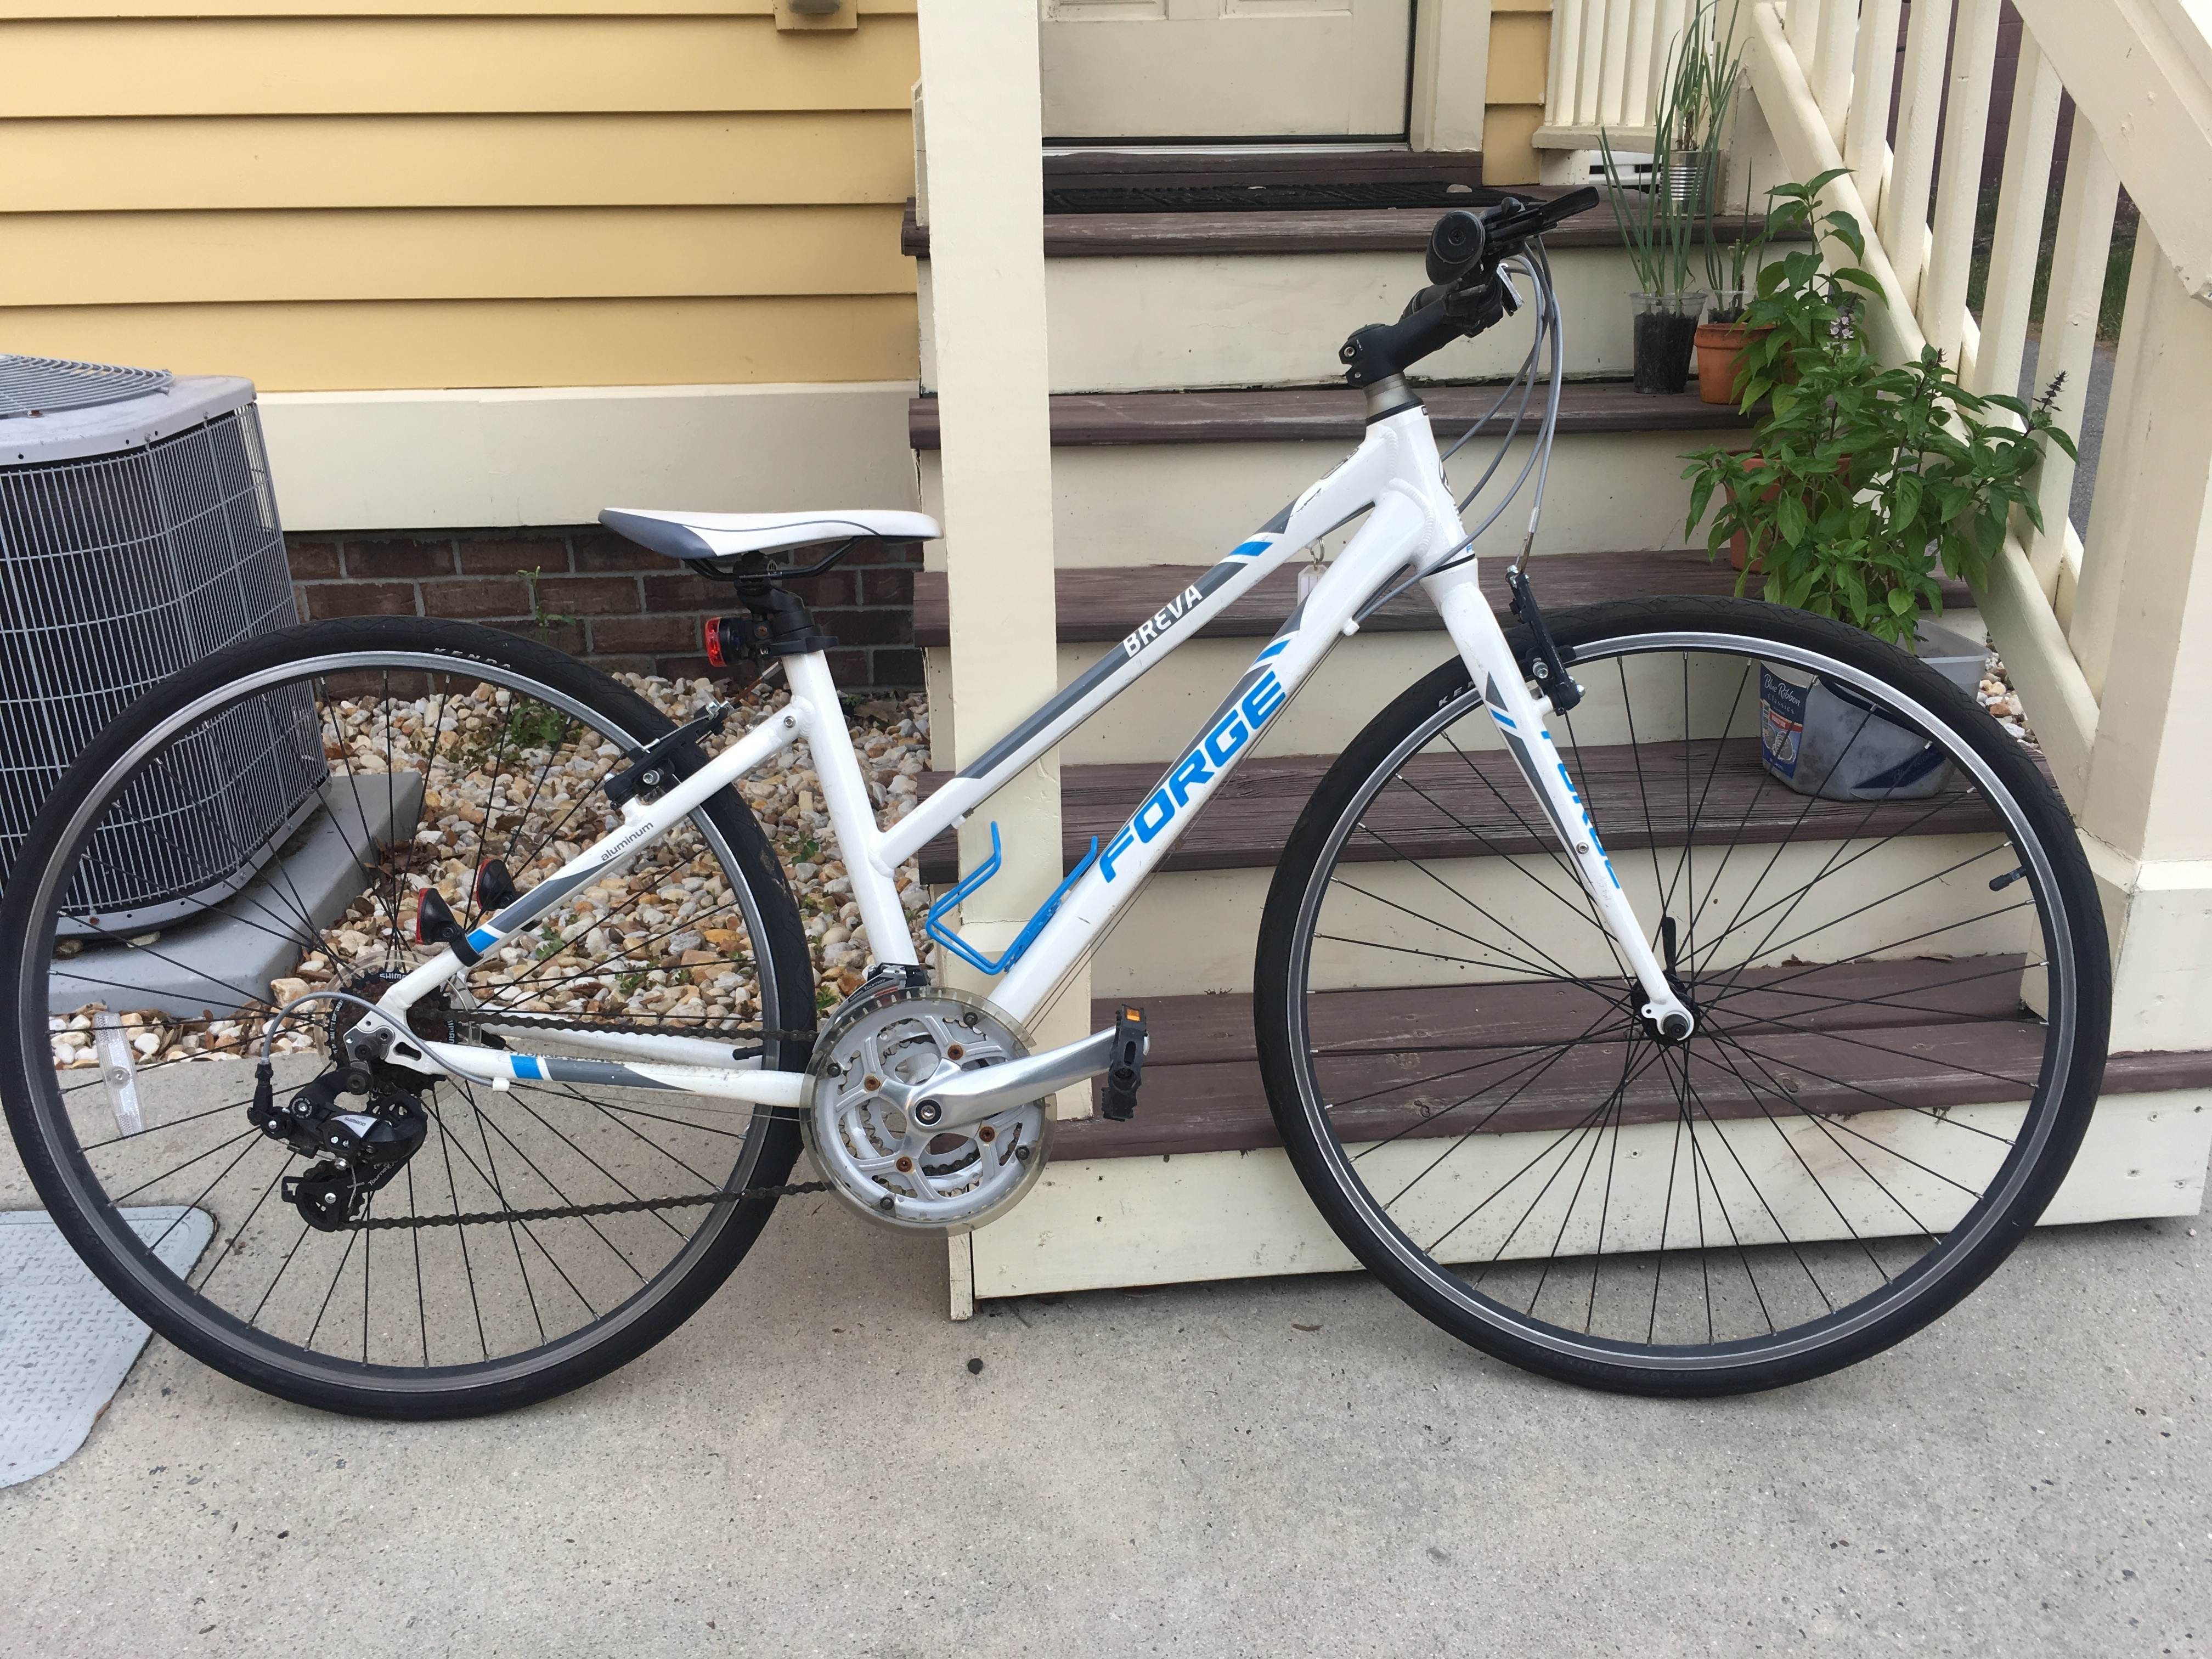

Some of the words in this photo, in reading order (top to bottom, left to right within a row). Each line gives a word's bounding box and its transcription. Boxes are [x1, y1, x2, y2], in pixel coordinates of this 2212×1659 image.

[1122, 585, 1203, 658] BREVA
[1764, 674, 1778, 692] Blue
[1778, 683, 1801, 707] Ribbon
[1099, 670, 1286, 883] FORGE
[601, 822, 654, 861] aluminum
[344, 1116, 366, 1126] SHIMANO
